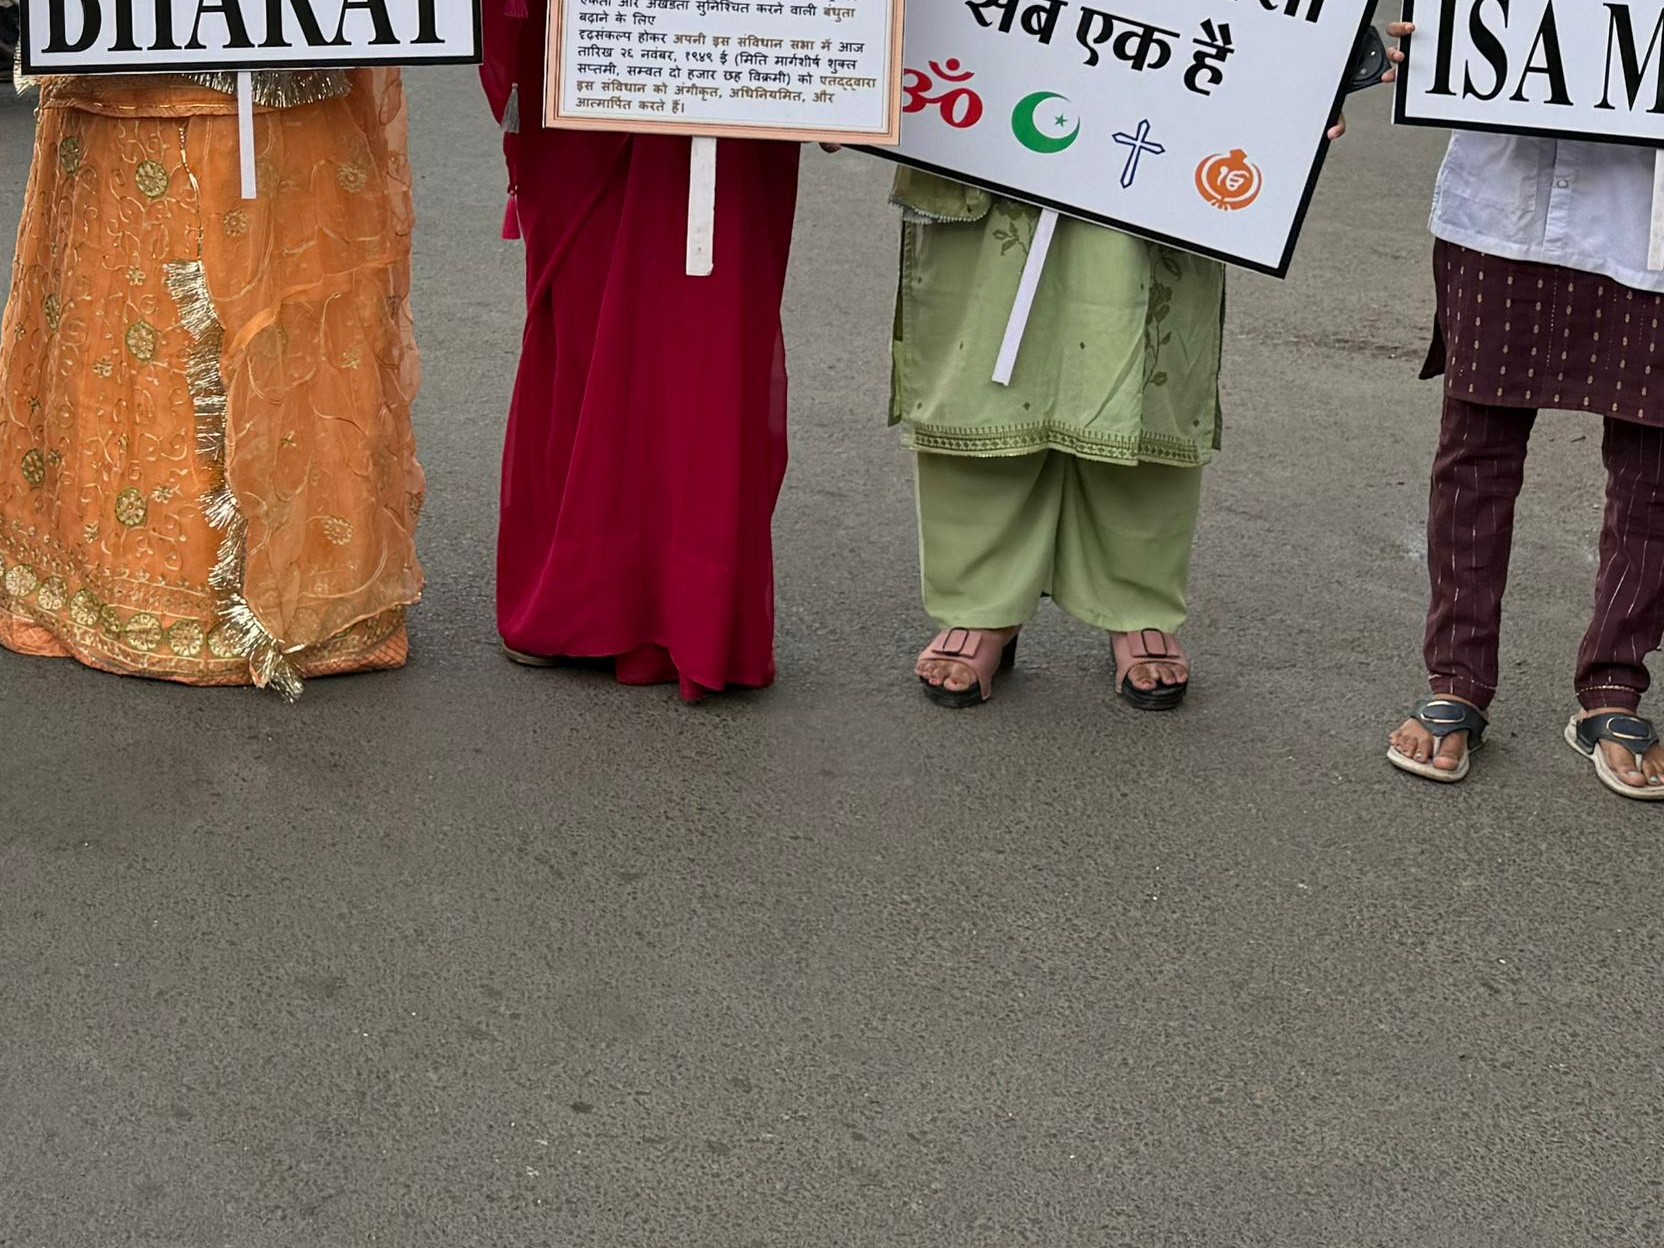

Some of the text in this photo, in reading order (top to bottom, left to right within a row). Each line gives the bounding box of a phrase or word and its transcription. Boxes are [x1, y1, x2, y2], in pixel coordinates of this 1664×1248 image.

[615, 11, 627, 24] के
[632, 12, 656, 26] लिए
[756, 2, 784, 15] करने
[790, 3, 818, 16] वाली
[823, 4, 856, 22] बंधुता
[638, 29, 668, 44] होकर
[673, 32, 707, 45] अपनी
[712, 36, 731, 48] इस
[737, 34, 784, 49] संविधान
[790, 40, 815, 50] सभा
[821, 38, 832, 51] में
[838, 42, 865, 53] आज
[1076, 6, 1180, 72] एक
[1183, 18, 1235, 96] है
[577, 44, 614, 57] तारिख
[735, 51, 769, 67] (मिति
[827, 58, 858, 74] शुक्ल
[1593, 2, 1664, 115] M
[669, 65, 682, 78] दो
[687, 69, 717, 80] हजार
[723, 70, 743, 83] छह
[748, 69, 791, 86] विक्रमी)
[797, 72, 814, 85] को
[576, 80, 595, 92] इस
[601, 78, 647, 93] संविधान
[653, 82, 668, 94] को
[812, 90, 835, 103] और
[638, 99, 666, 111] करते
